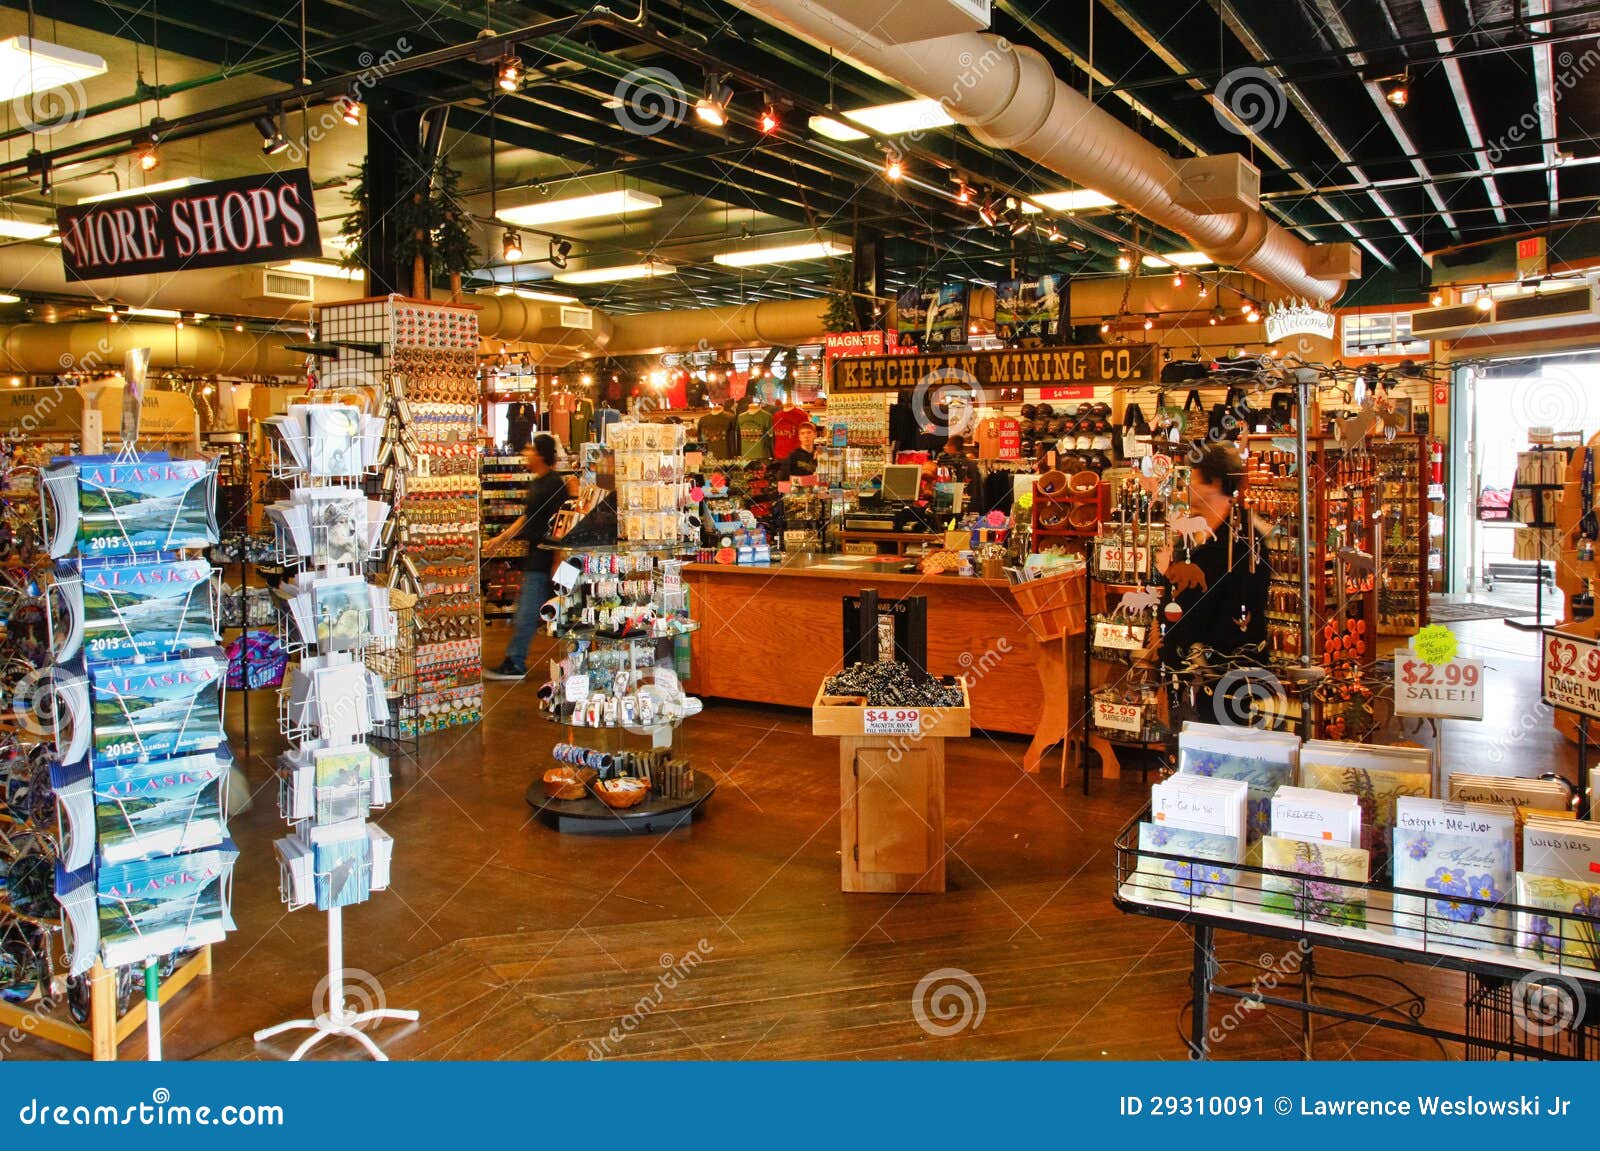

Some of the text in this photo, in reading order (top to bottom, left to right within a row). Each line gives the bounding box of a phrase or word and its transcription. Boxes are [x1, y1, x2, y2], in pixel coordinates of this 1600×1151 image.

[70, 182, 307, 269] MORE SHOPS
[844, 349, 1141, 388] KETCHIKAN MINING CO.
[90, 465, 201, 484] ALASKA
[93, 568, 201, 587] ALASKA
[105, 668, 212, 693] ALASKA
[1401, 660, 1479, 687] $2.99
[1406, 686, 1476, 702] SALE!!
[1549, 676, 1585, 698] TRAVEL
[866, 710, 918, 723] $4.99
[1099, 703, 1137, 717] $2.99
[108, 769, 214, 796] ALASKA
[109, 868, 214, 897] ALASKA
